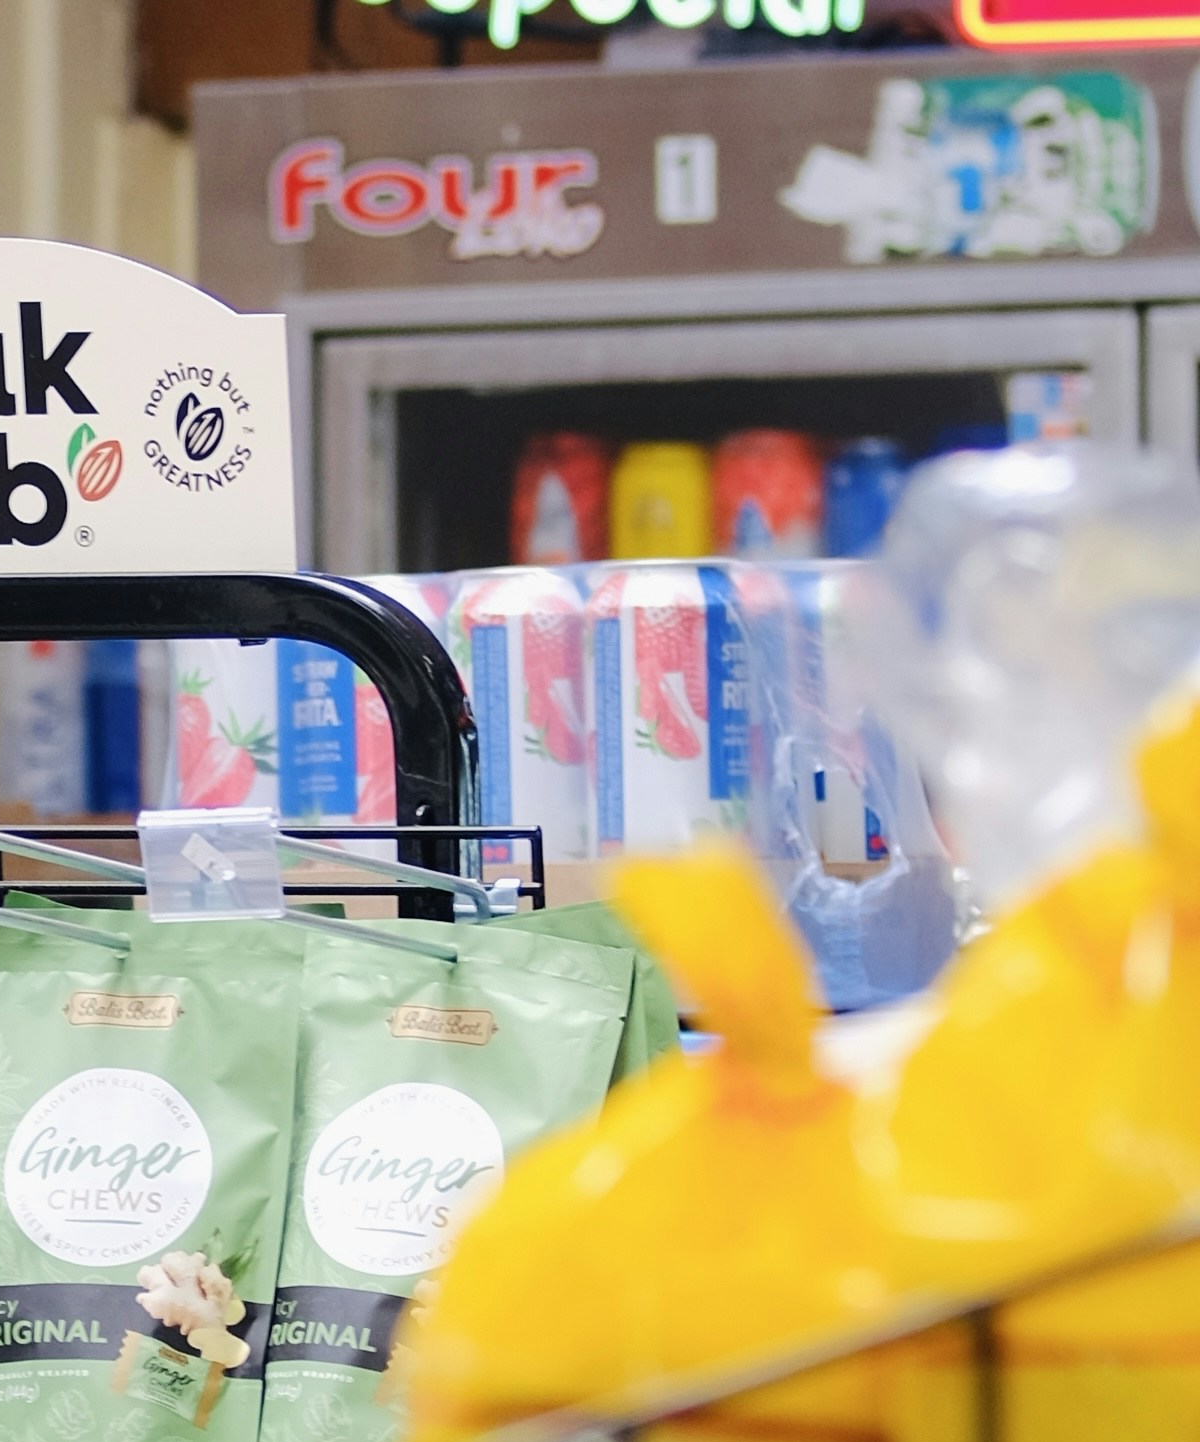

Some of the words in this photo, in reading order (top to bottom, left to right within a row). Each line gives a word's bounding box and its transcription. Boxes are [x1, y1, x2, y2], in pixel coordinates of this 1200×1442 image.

[144, 362, 213, 417] nothing
[218, 371, 252, 414] but
[144, 440, 252, 492] GREATNESS
[70, 1078, 108, 1095] WITH
[112, 1078, 146, 1093] REAL
[151, 1087, 192, 1131] GINGER
[19, 1126, 201, 1193] Ginger
[318, 1135, 495, 1203] Ginger
[48, 1189, 163, 1214] CHEWS
[353, 1199, 450, 1229] HEWS
[54, 1238, 96, 1258] SPICY
[101, 1237, 152, 1259] CHEWY
[156, 1197, 192, 1238] CANDY
[276, 1299, 298, 1319] icy
[269, 1320, 377, 1353] RIGINAL
